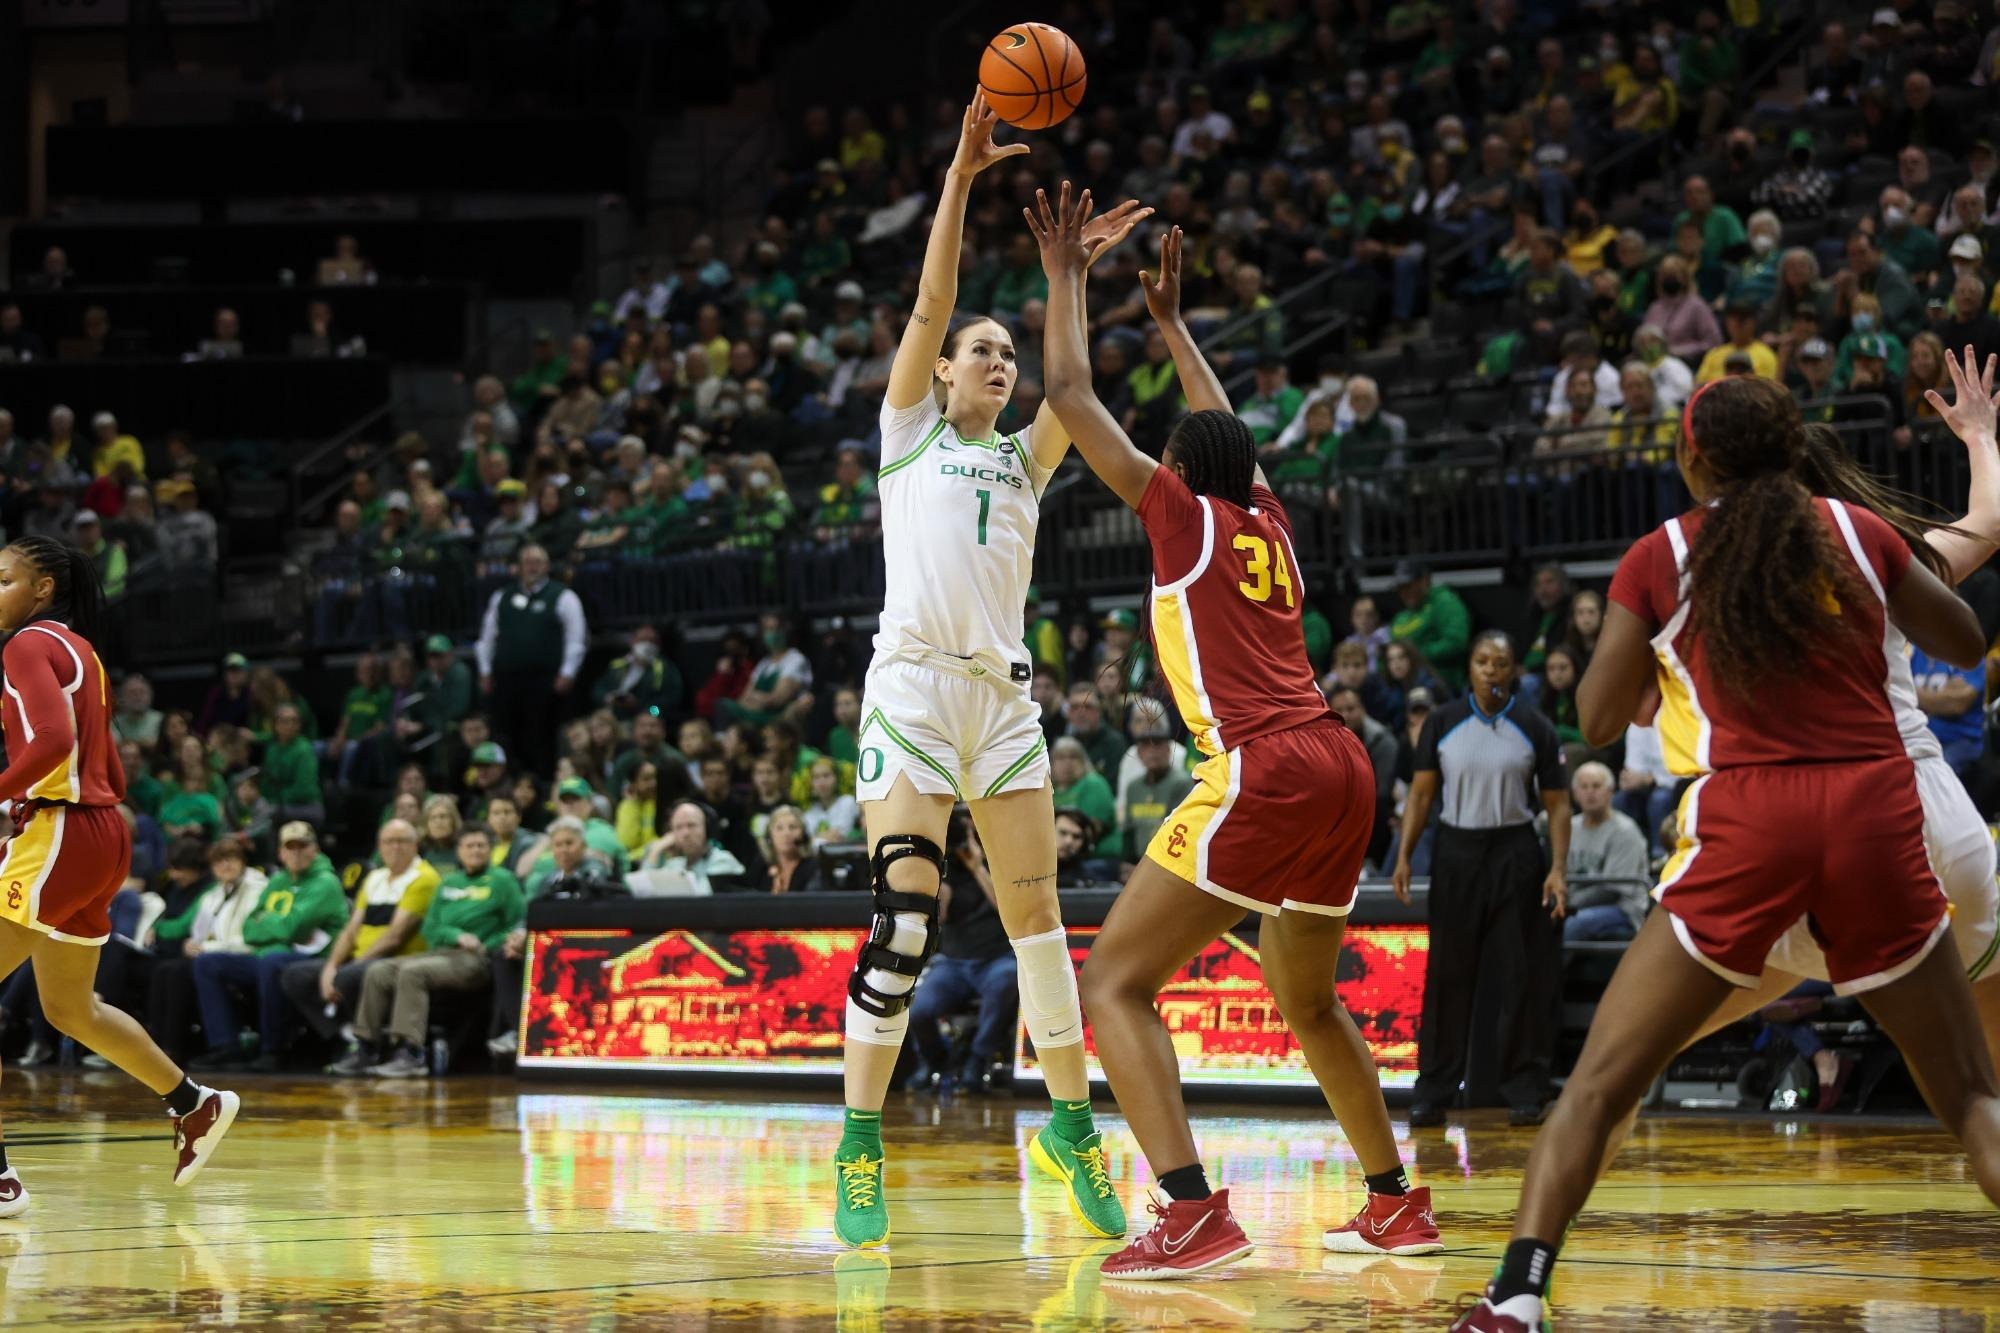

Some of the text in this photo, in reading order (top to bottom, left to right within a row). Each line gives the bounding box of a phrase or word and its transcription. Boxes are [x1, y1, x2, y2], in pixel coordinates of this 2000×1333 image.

[941, 464, 1023, 489] DUCKS
[976, 489, 991, 546] 1
[1232, 534, 1295, 609] 34
[859, 747, 884, 783] O
[1167, 823, 1188, 858] SC
[7, 880, 23, 909] SC
